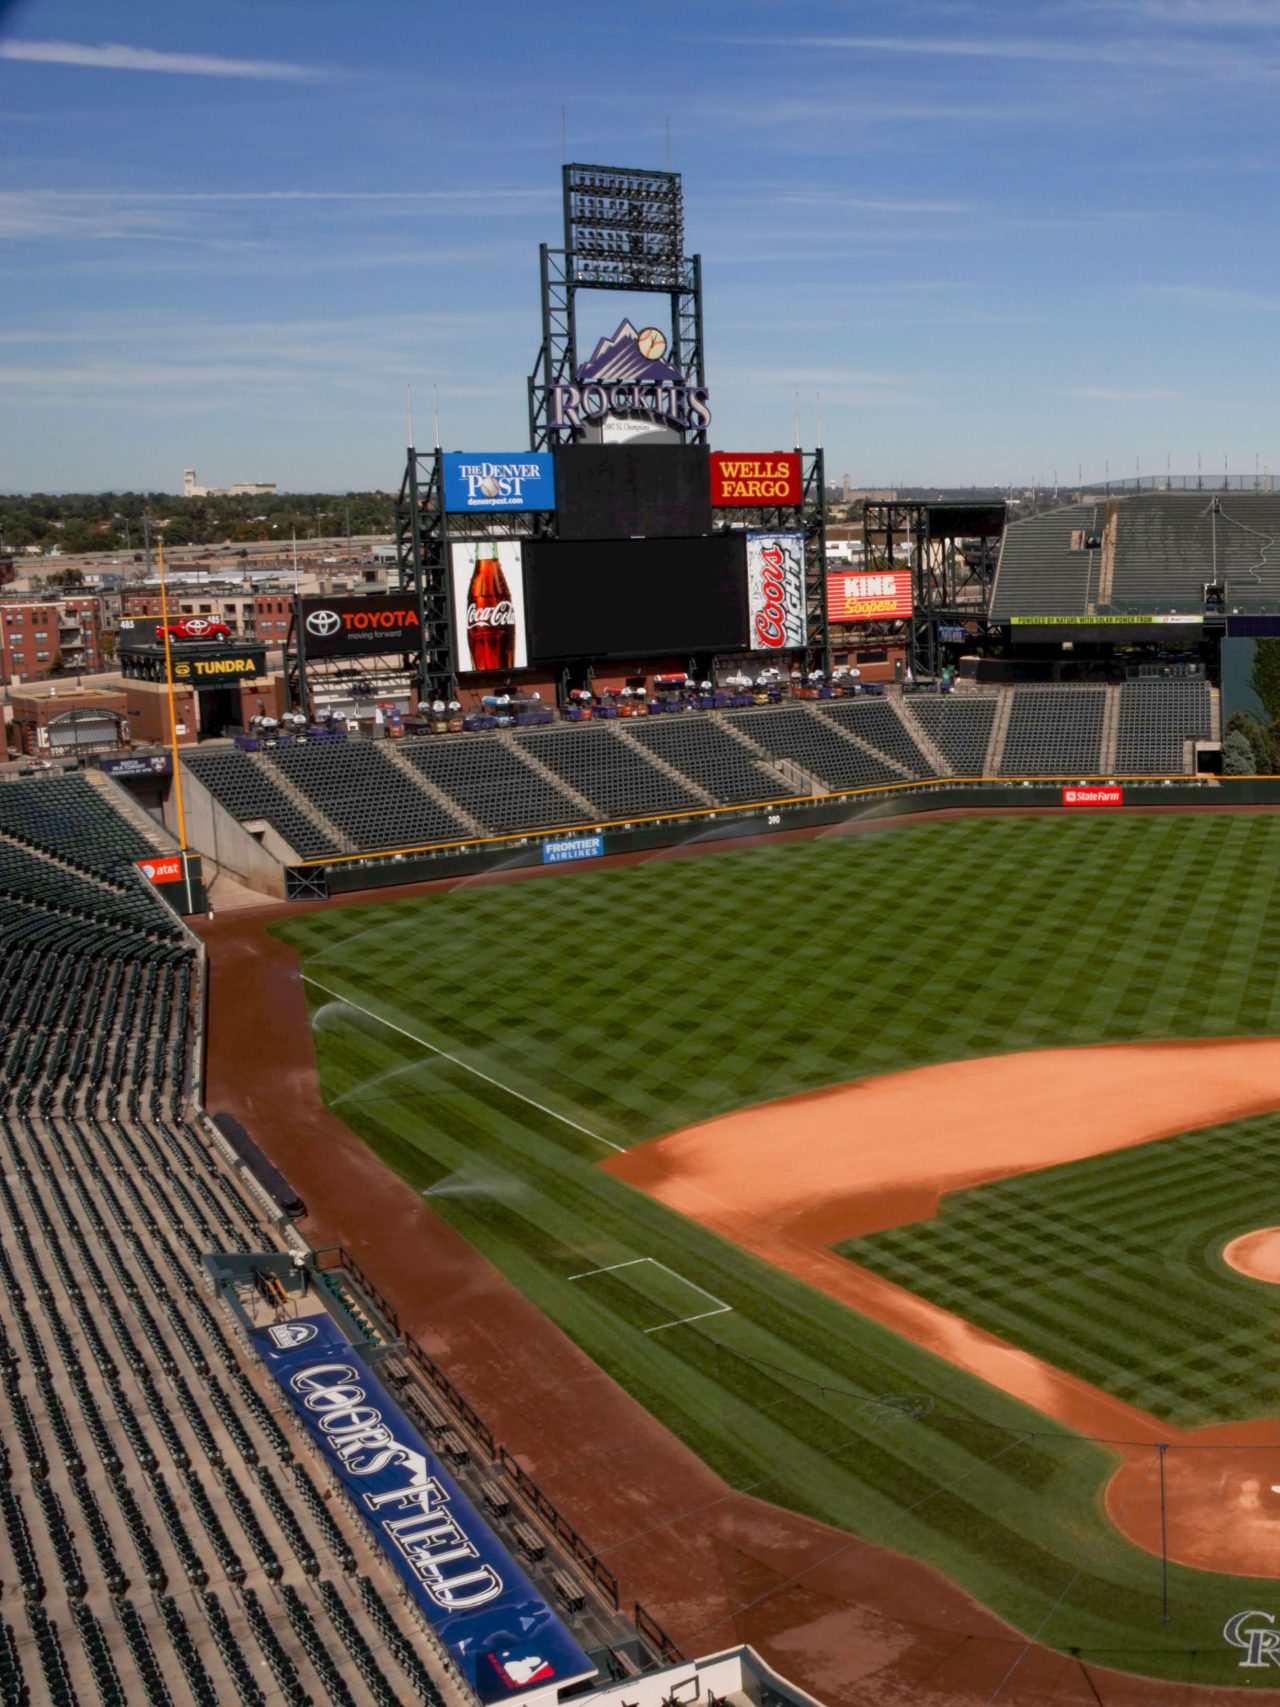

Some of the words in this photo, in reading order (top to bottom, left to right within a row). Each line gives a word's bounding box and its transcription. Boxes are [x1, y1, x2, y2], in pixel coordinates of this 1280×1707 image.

[550, 384, 712, 430] ROCKIES
[458, 465, 482, 478] THE
[482, 463, 541, 478] DENVER
[719, 462, 790, 478] WELLS
[721, 481, 790, 497] FARGO
[468, 498, 523, 506] denverpost.com
[844, 576, 897, 597] KING
[755, 542, 786, 649] Coors
[783, 547, 802, 645] LIGHT
[467, 601, 516, 628] Coca-Cola
[844, 598, 897, 617] Soopers
[120, 620, 135, 629] 485
[342, 611, 419, 629] TOYOTA
[1096, 616, 1113, 624] SOLAR
[1114, 616, 1133, 624] POWER
[1135, 616, 1152, 624] FROM
[347, 632, 373, 640] moving
[374, 630, 402, 638] forward
[194, 659, 256, 675] TUNDRA
[1076, 791, 1097, 800] State
[1098, 791, 1119, 800] Farm
[768, 815, 780, 825] 390
[546, 838, 600, 853] FRONTIER
[549, 847, 598, 862] AIRLINES
[157, 863, 179, 876] at&t
[290, 1363, 410, 1475] COORS
[363, 1477, 504, 1609] FIELD
